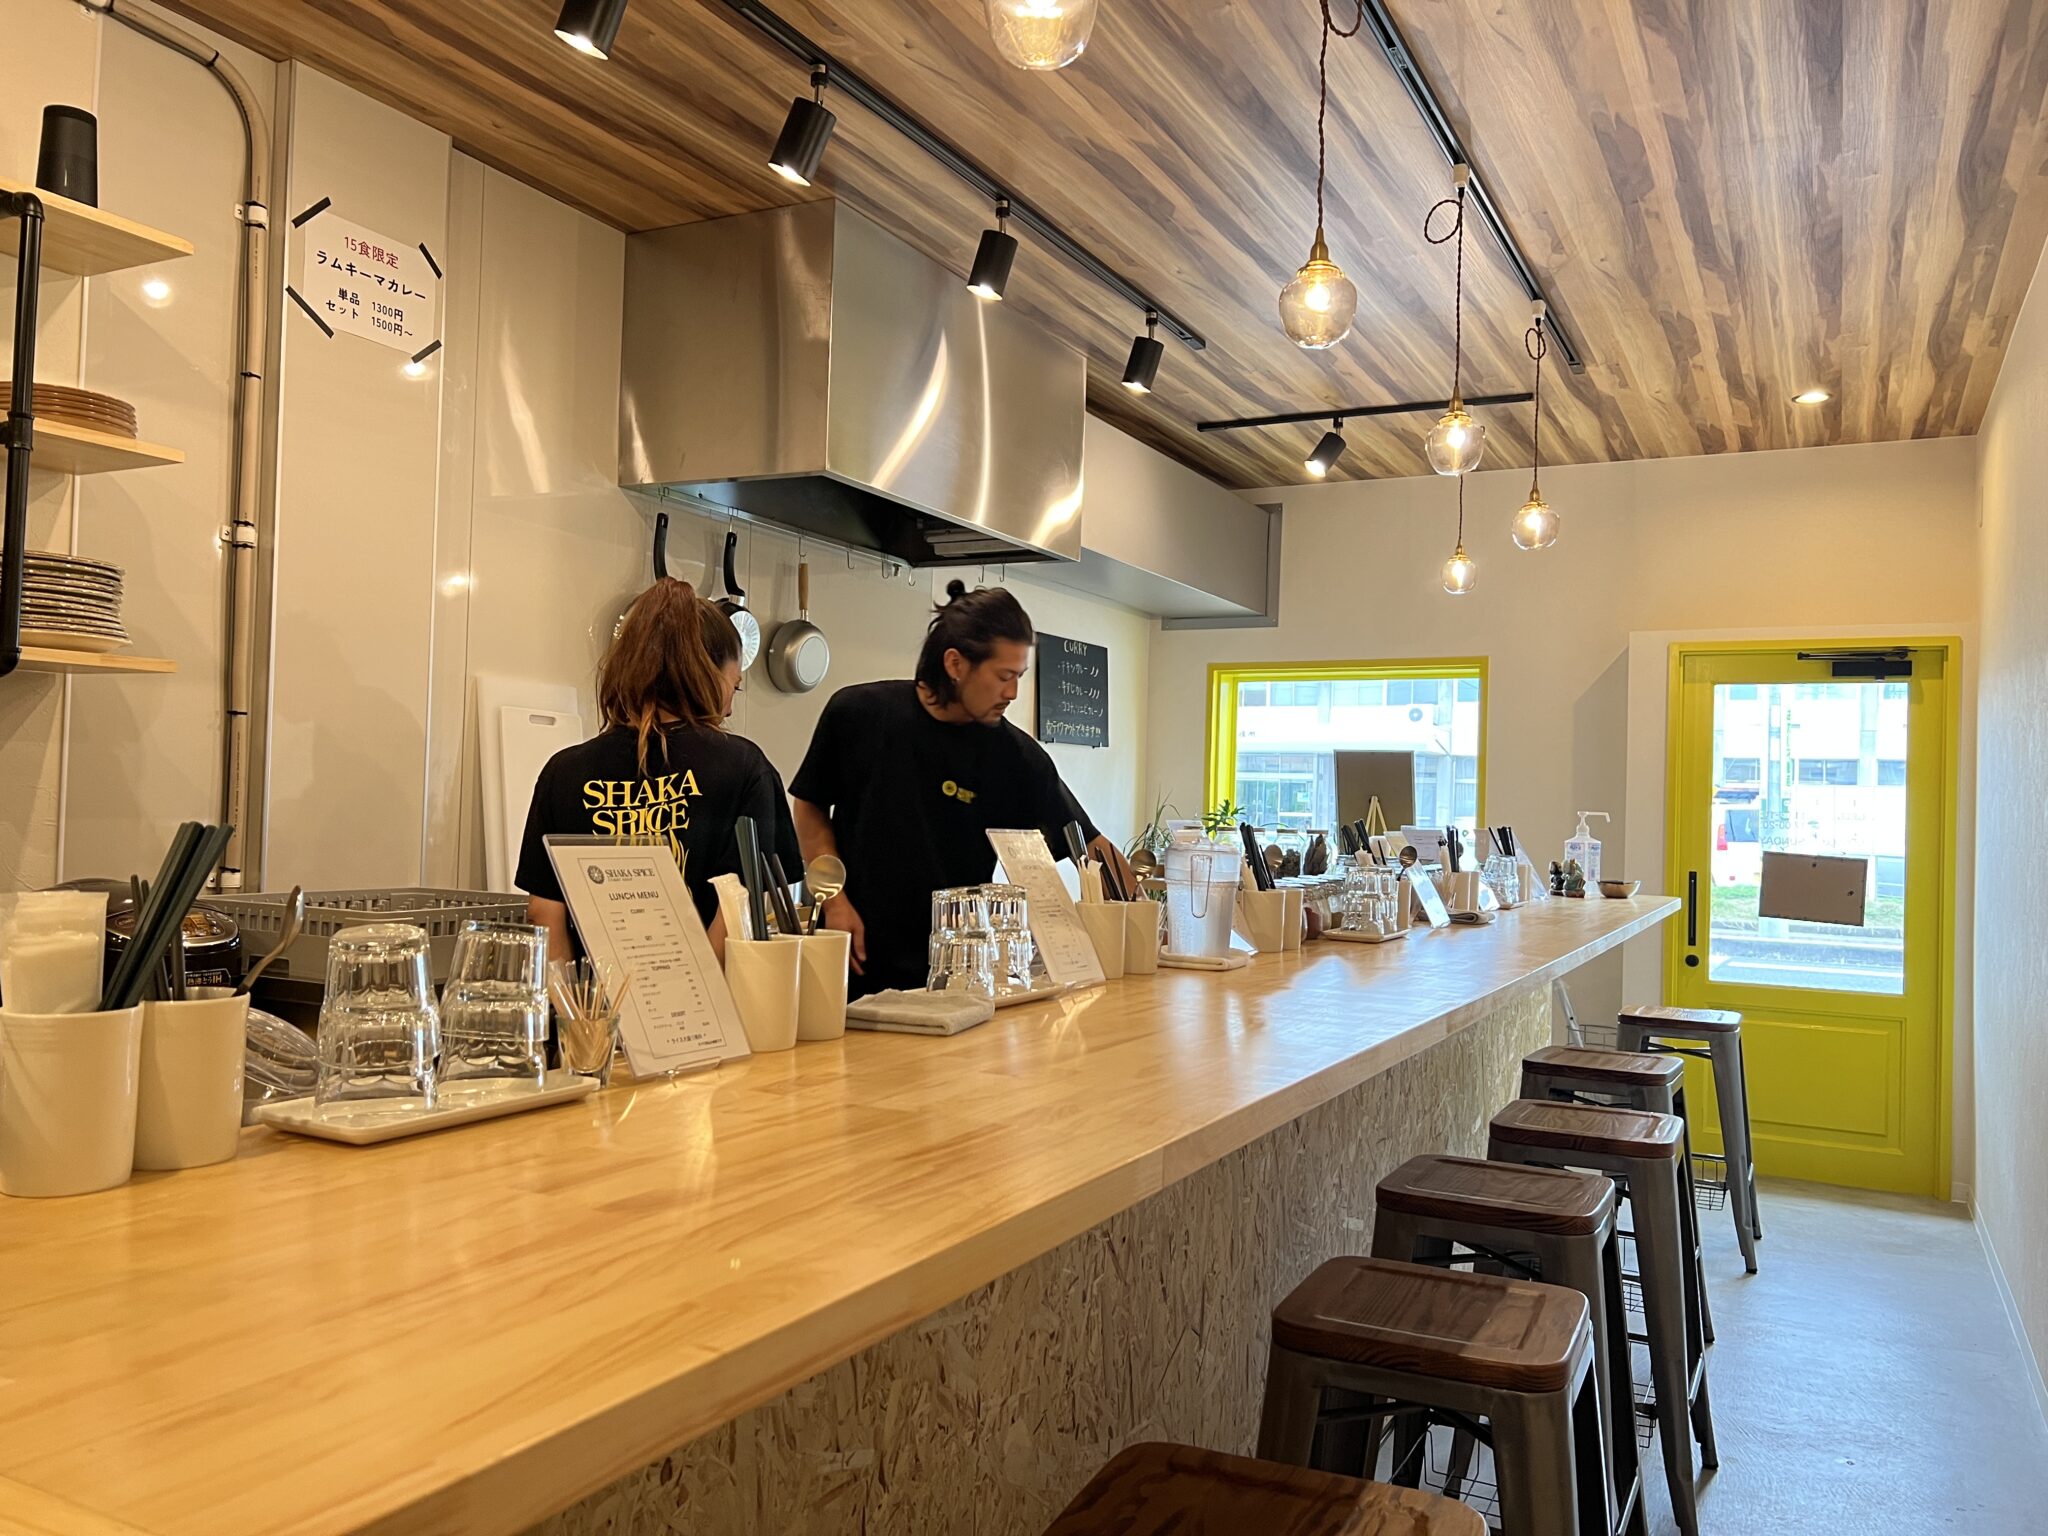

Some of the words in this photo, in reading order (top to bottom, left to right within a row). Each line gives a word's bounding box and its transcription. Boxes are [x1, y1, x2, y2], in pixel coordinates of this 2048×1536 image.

[344, 236, 399, 270] 15食限定
[316, 250, 426, 300] ラムキーマカレー
[325, 300, 359, 319] セット
[338, 287, 361, 306] 単品
[371, 301, 404, 322] 1300円
[1063, 640, 1088, 657] CURRY
[582, 769, 703, 809] SHAKA
[592, 799, 690, 838] SPICE
[604, 869, 633, 877] SHAKA
[633, 868, 656, 877] SPICE
[608, 891, 636, 901] LUNCH
[636, 890, 660, 899] MENU
